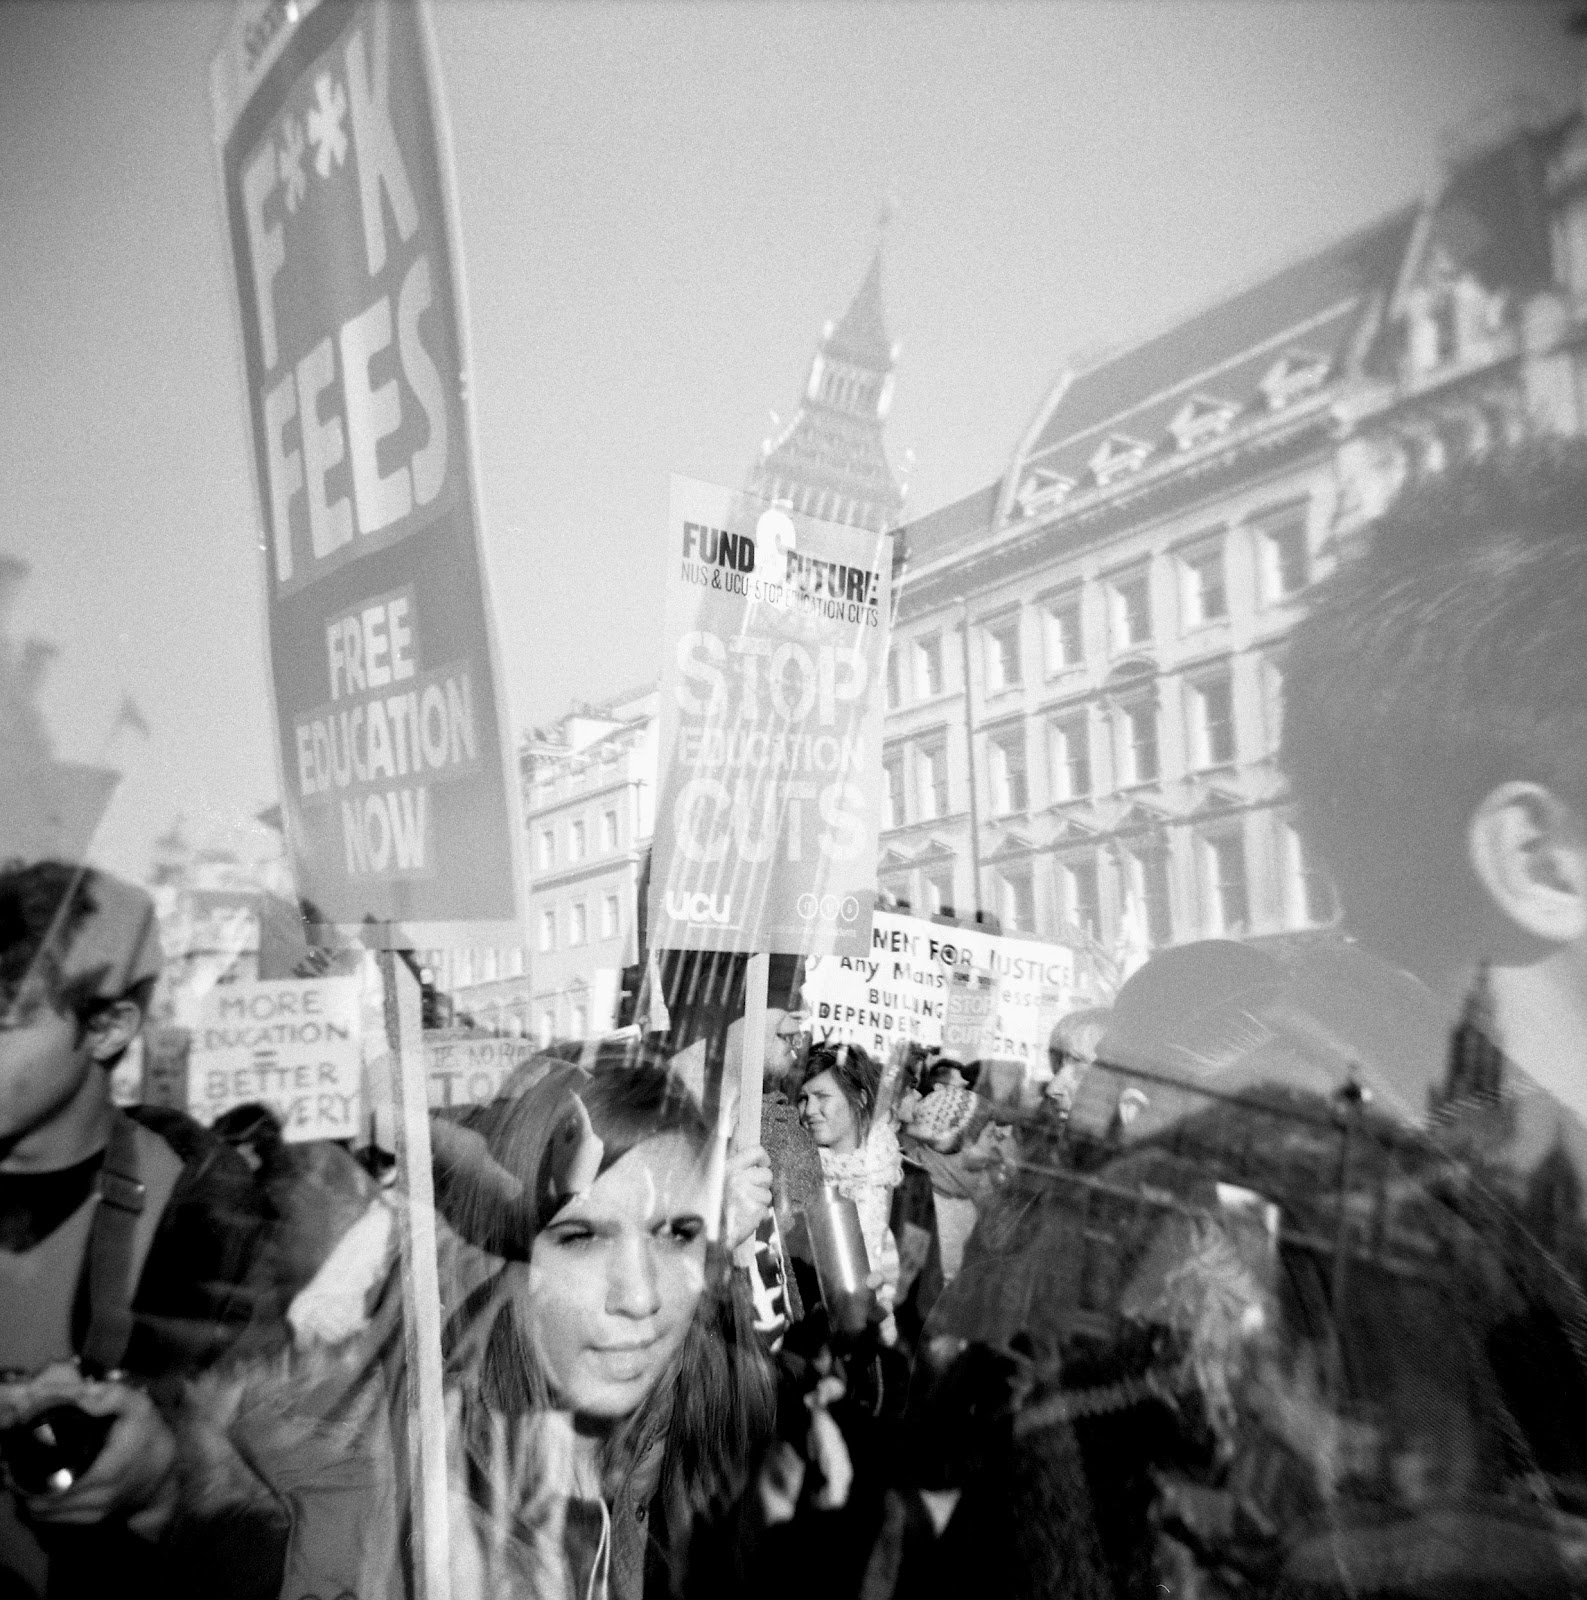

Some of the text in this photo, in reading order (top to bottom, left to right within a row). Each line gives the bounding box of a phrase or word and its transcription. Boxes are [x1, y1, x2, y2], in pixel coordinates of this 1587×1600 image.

[262, 253, 448, 581] FEES
[682, 520, 756, 574] FUND
[786, 549, 880, 606] FUTURE
[681, 562, 708, 588] NUS
[711, 569, 722, 590] &
[754, 580, 783, 605] STOP
[848, 604, 879, 628] CUTS
[326, 596, 416, 700] FREE
[674, 631, 868, 724] STOP
[296, 672, 477, 796] EDUCATION
[679, 727, 864, 773] EDUCATION
[342, 787, 427, 875] NOW
[674, 778, 867, 863] CUTS
[840, 955, 881, 984] Any
[928, 938, 973, 967] FOR
[218, 990, 323, 1021] MORE
[205, 1062, 339, 1100] BETTER
